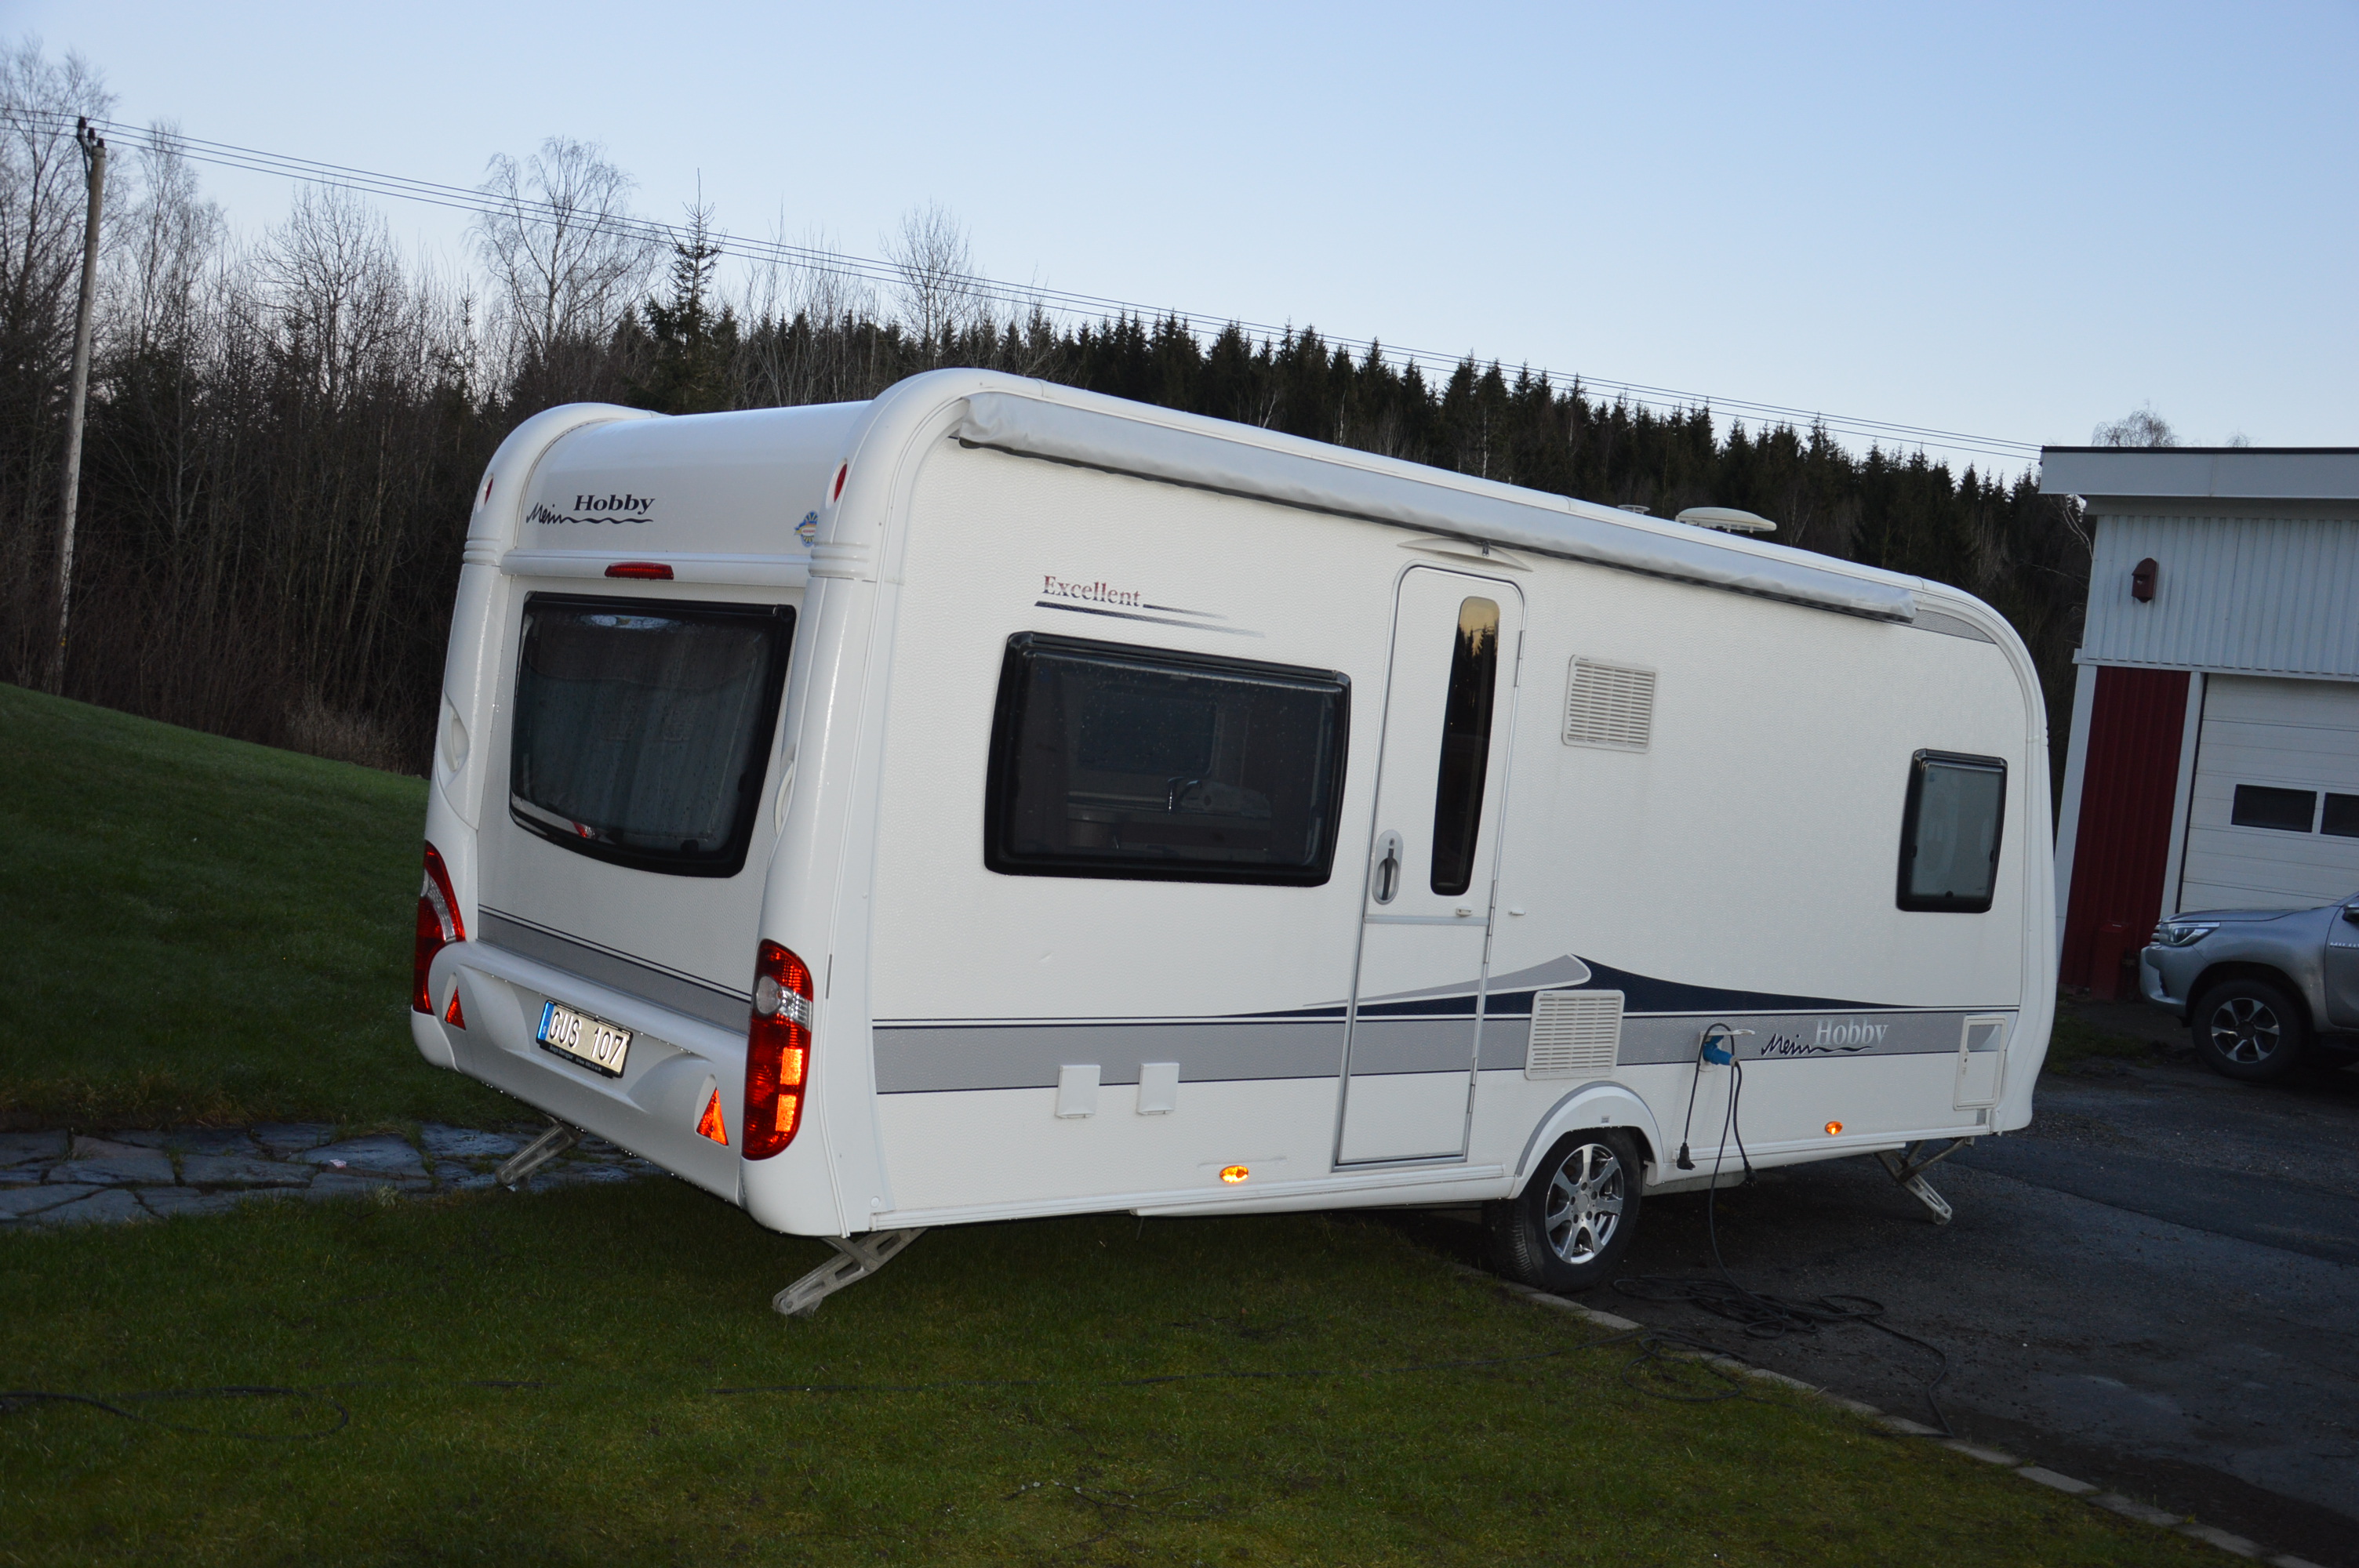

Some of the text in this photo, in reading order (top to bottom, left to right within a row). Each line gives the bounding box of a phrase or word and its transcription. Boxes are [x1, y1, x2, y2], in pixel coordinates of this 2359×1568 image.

[526, 494, 656, 524] Mein Hobby
[1042, 575, 1140, 607] Excellent
[550, 1011, 582, 1048] GUS
[591, 1026, 627, 1065] 107
[1761, 1018, 1889, 1056] Mein Hobby
